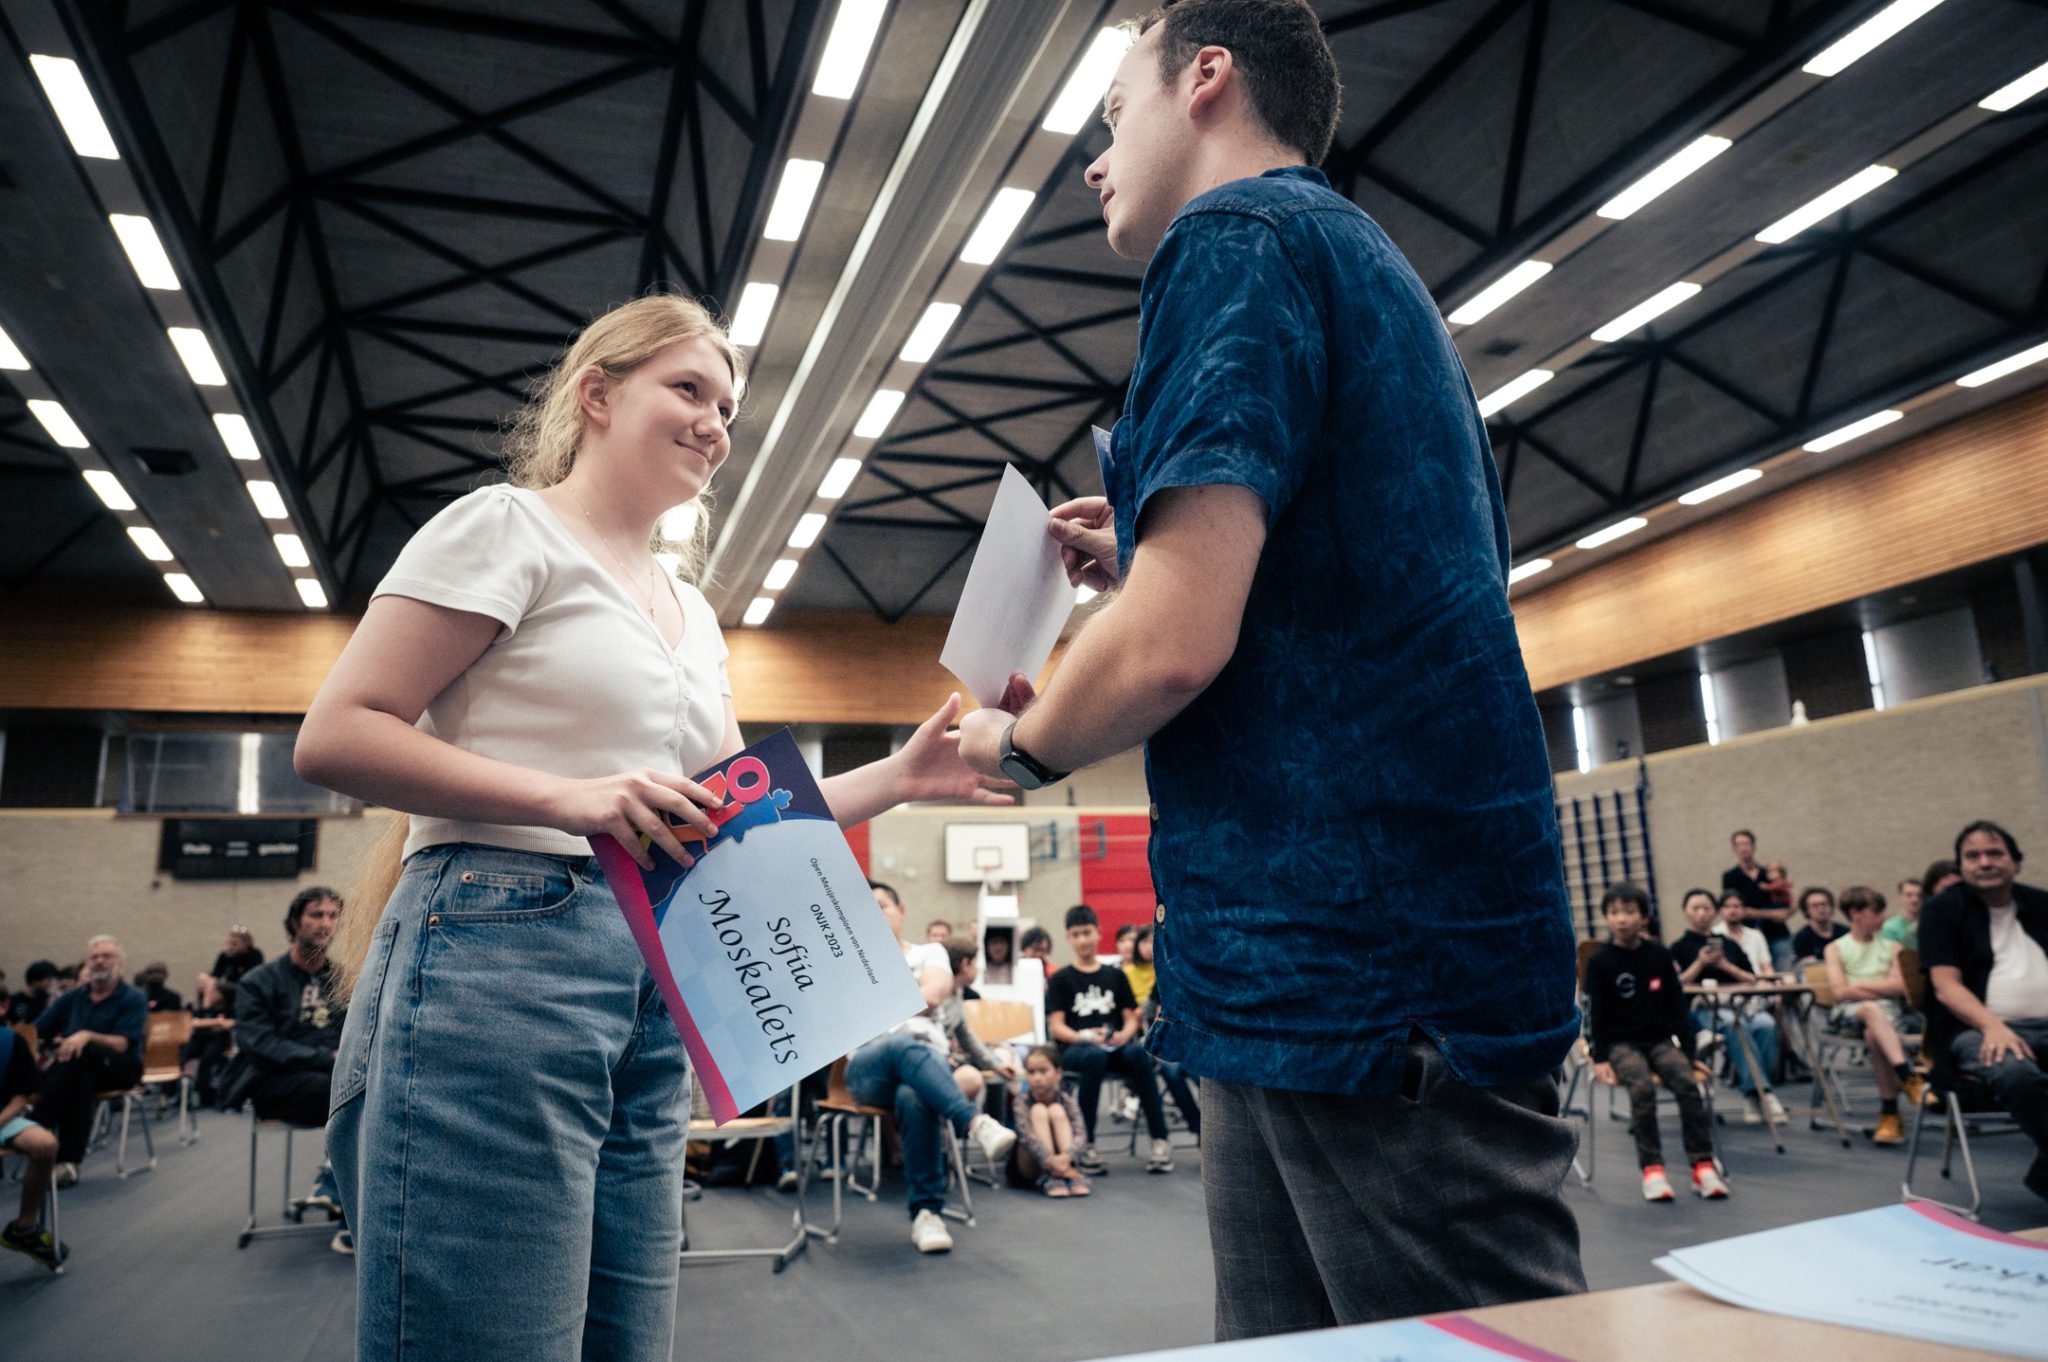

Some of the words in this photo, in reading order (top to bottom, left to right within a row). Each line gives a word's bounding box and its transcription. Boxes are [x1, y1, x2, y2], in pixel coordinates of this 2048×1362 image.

[766, 917, 814, 992] Sofiia
[810, 857, 823, 877] Open
[821, 876, 853, 935] Meisjeskampioen
[850, 935, 861, 950] van
[857, 949, 879, 985] Nederland
[810, 903, 831, 932] ONJK
[824, 932, 844, 959] 2023
[698, 889, 799, 1065] Moskalets
